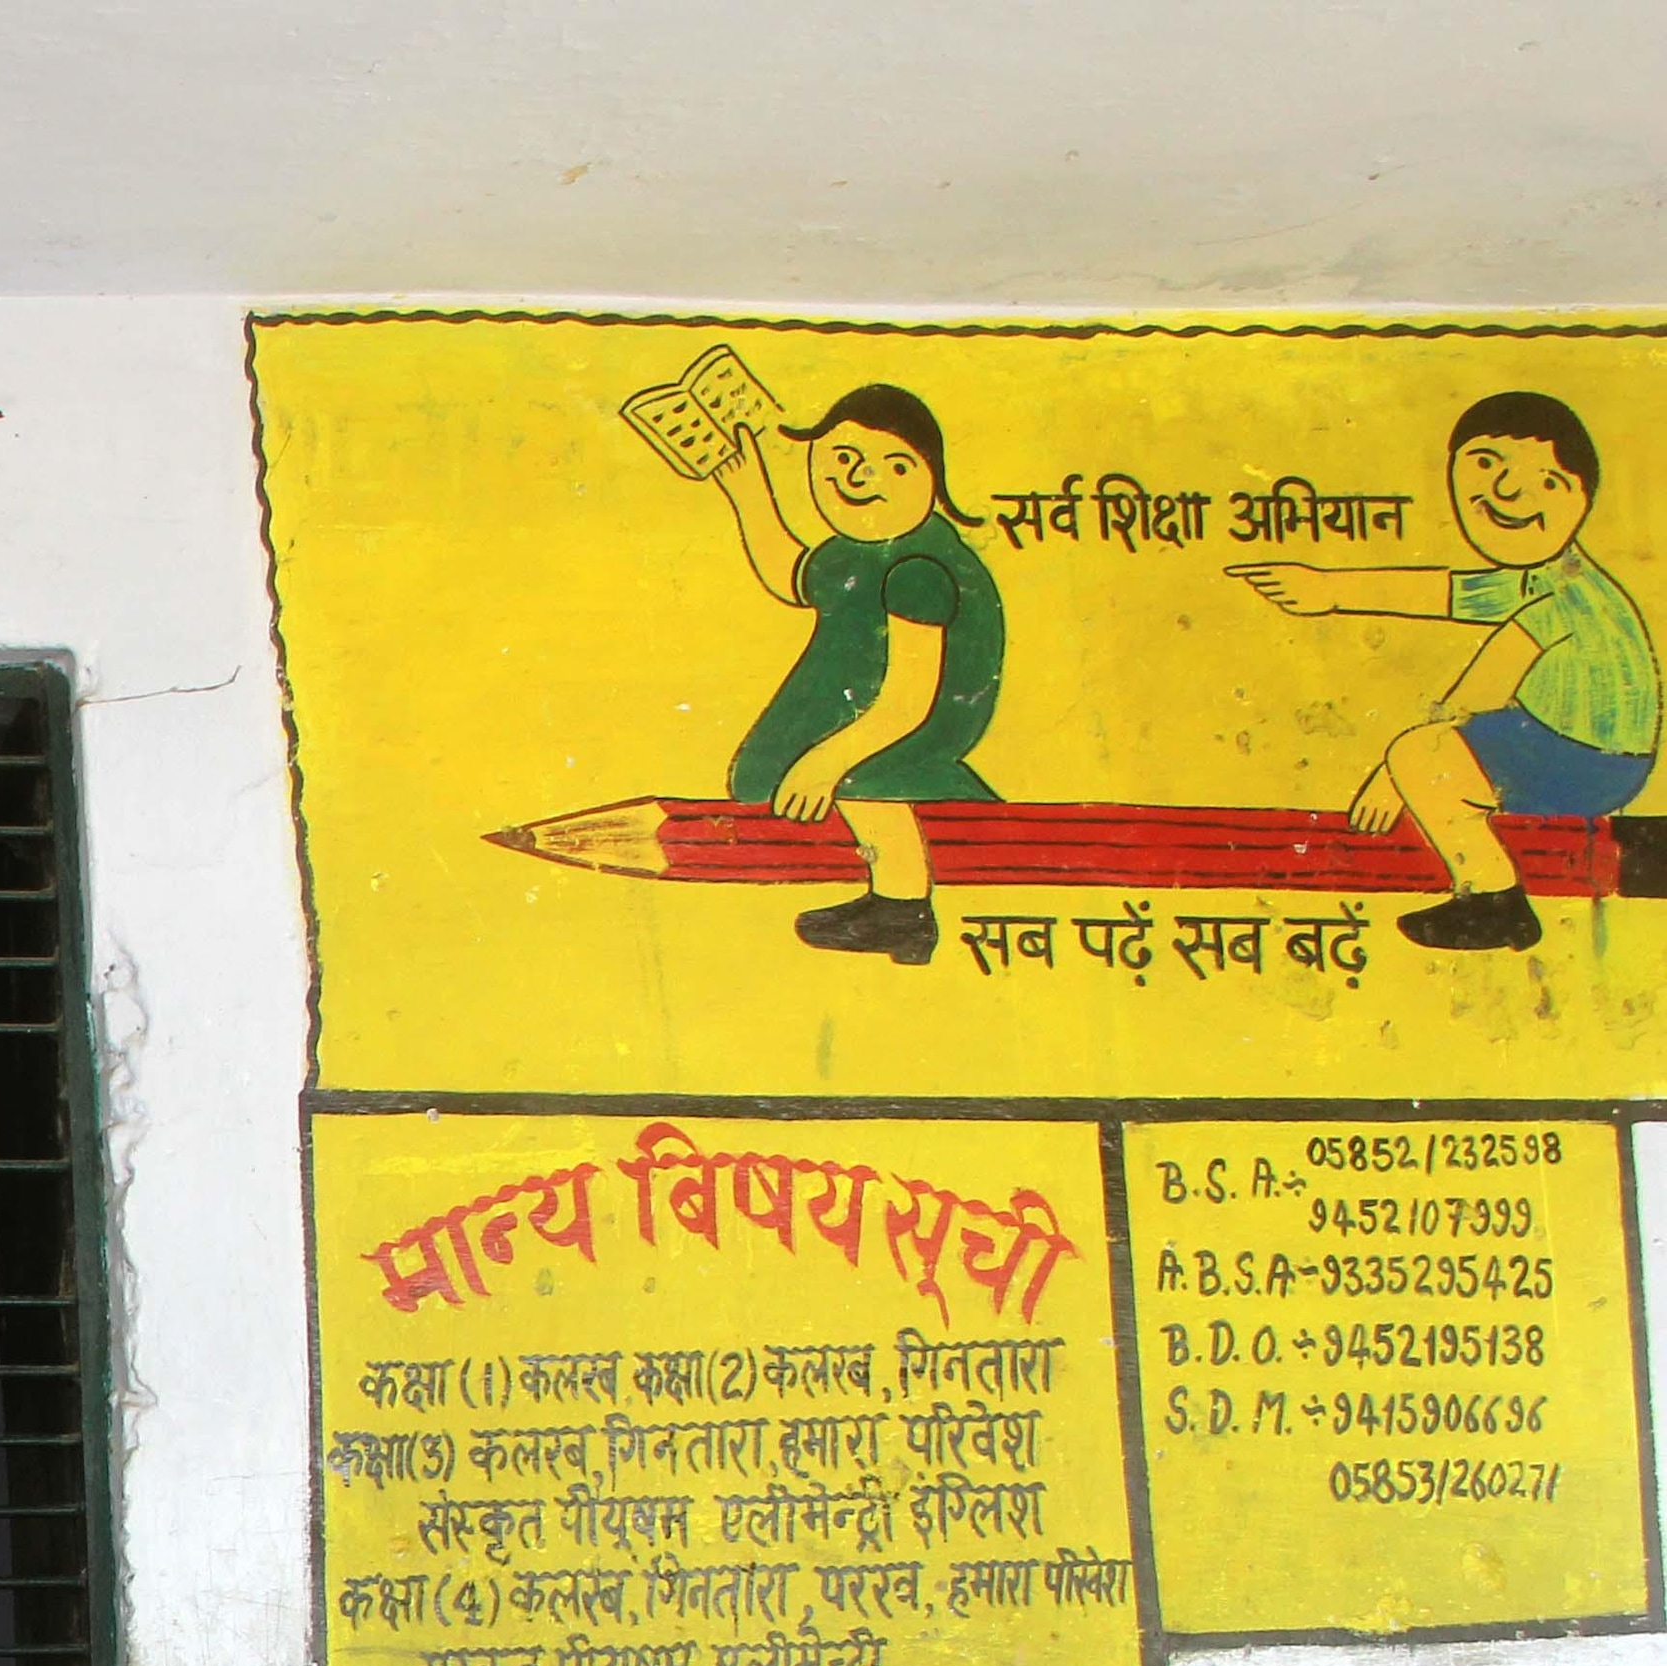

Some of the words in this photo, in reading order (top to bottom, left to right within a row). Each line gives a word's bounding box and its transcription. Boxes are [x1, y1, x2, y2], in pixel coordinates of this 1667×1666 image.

[991, 473, 1084, 549] सर्व
[1090, 473, 1212, 552] शिक्षा
[1227, 476, 1414, 545] अभियान
[960, 916, 1058, 976] सब
[1171, 916, 1271, 980] सब
[885, 1170, 1085, 1332] सूची
[1308, 1197, 1532, 1238] 9452107999
[358, 1360, 456, 1414] कक्षा
[894, 1327, 1067, 1402] गिनतारा
[899, 1399, 1043, 1474] परिवेश
[418, 1489, 546, 1566] संस्कृत
[338, 1573, 430, 1632] कक्षा
[945, 1559, 1041, 1619] हमारा
